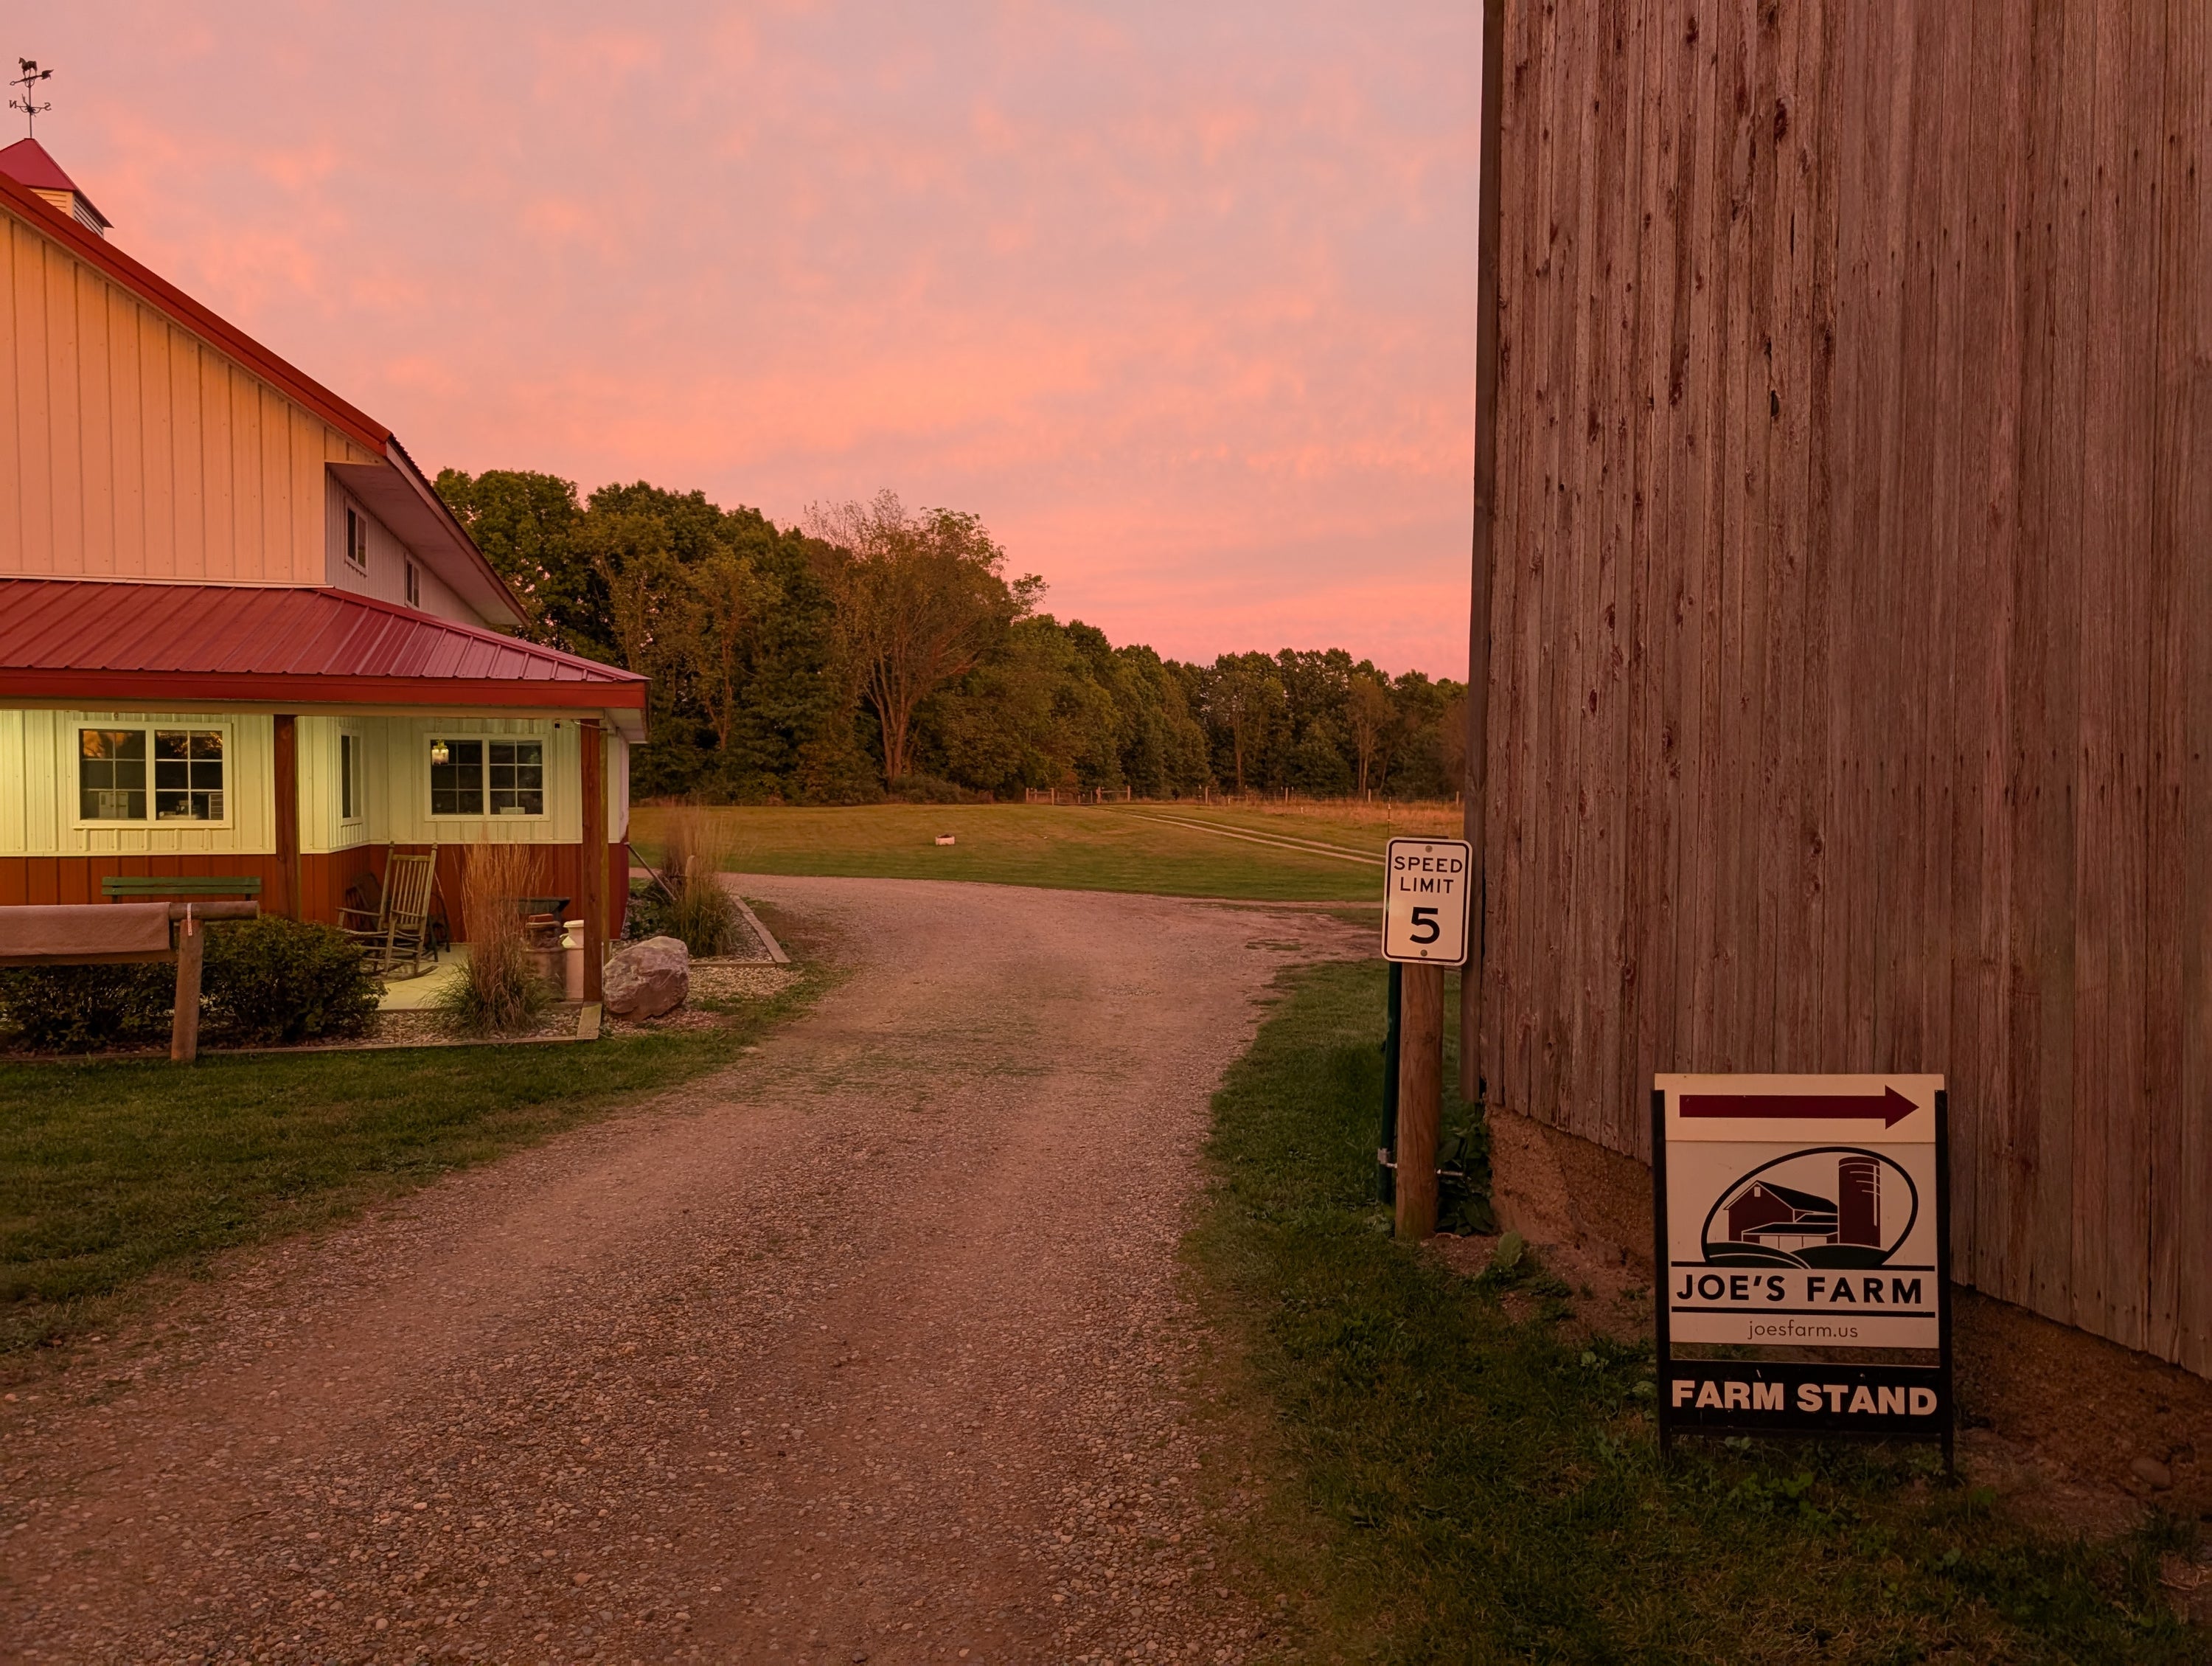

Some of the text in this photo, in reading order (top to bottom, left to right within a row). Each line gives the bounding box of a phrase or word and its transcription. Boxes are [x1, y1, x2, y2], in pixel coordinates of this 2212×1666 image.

[1394, 855, 1462, 873] SPEED
[1400, 877, 1453, 894] LIMIT
[1409, 906, 1440, 944] 5
[1676, 1274, 1921, 1305] JOE'S FARM
[1747, 1319, 1858, 1340] joesfarm.us
[1671, 1380, 1938, 1417] FARM STAND
